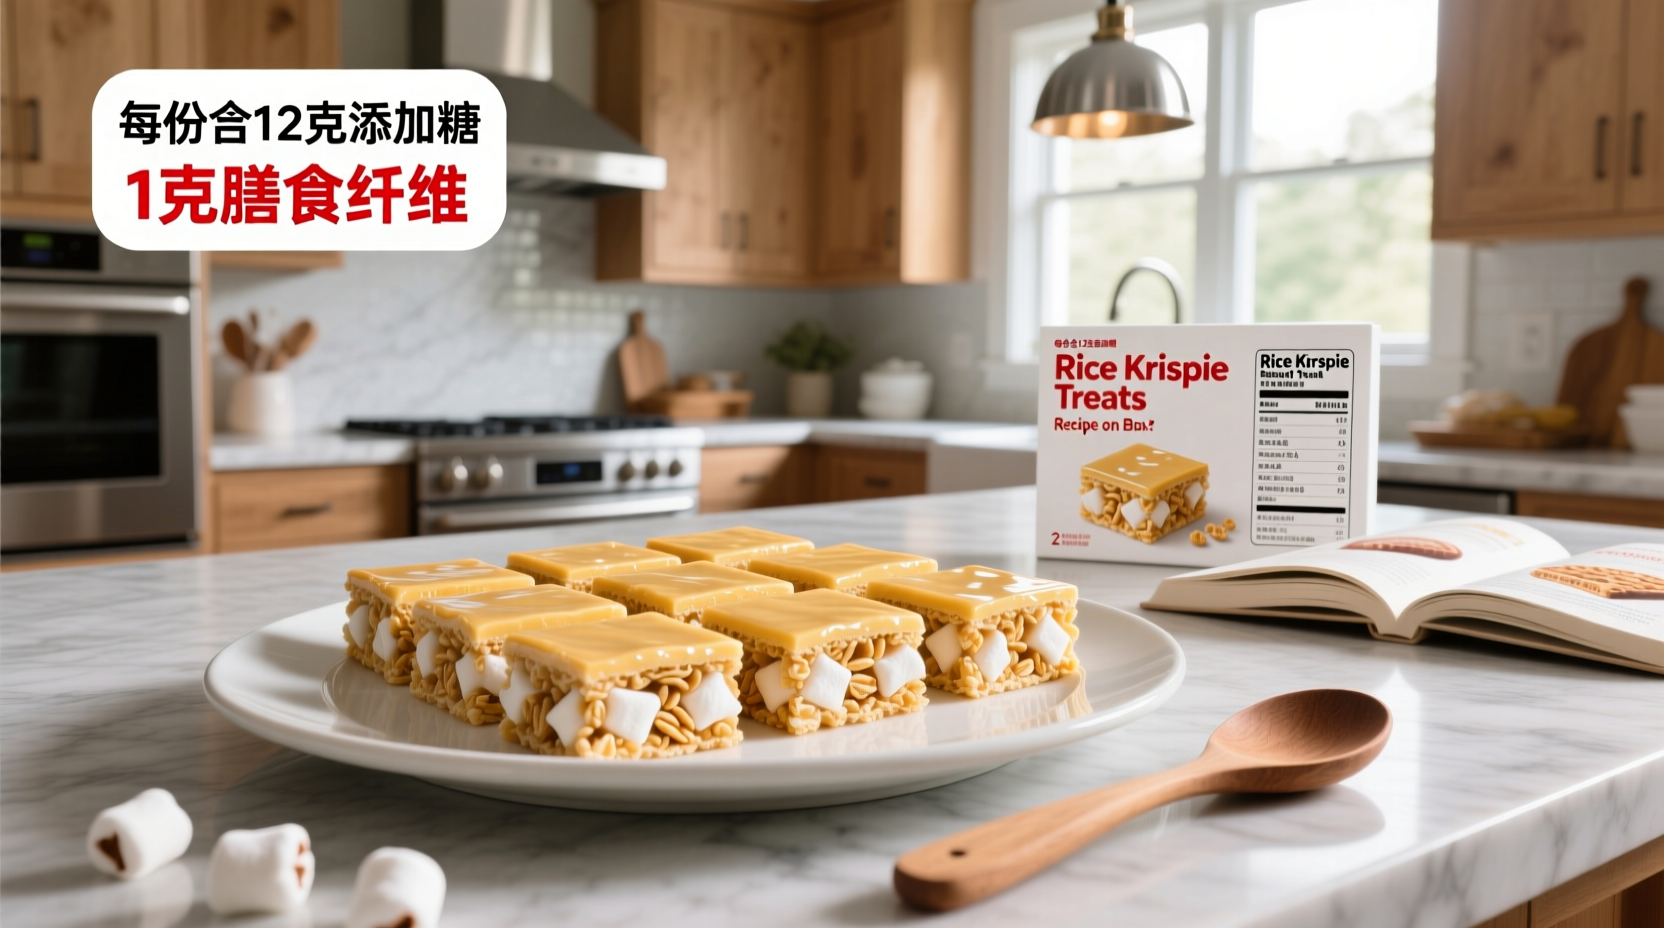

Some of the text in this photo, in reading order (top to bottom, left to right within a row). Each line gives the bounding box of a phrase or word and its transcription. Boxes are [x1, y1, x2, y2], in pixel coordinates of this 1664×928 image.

[1055, 352, 1229, 389] Rice Krispie
[1260, 353, 1292, 368] Rice
[1054, 384, 1147, 410] Treats
[1054, 417, 1098, 435] Recipe
[1102, 420, 1119, 431] on
